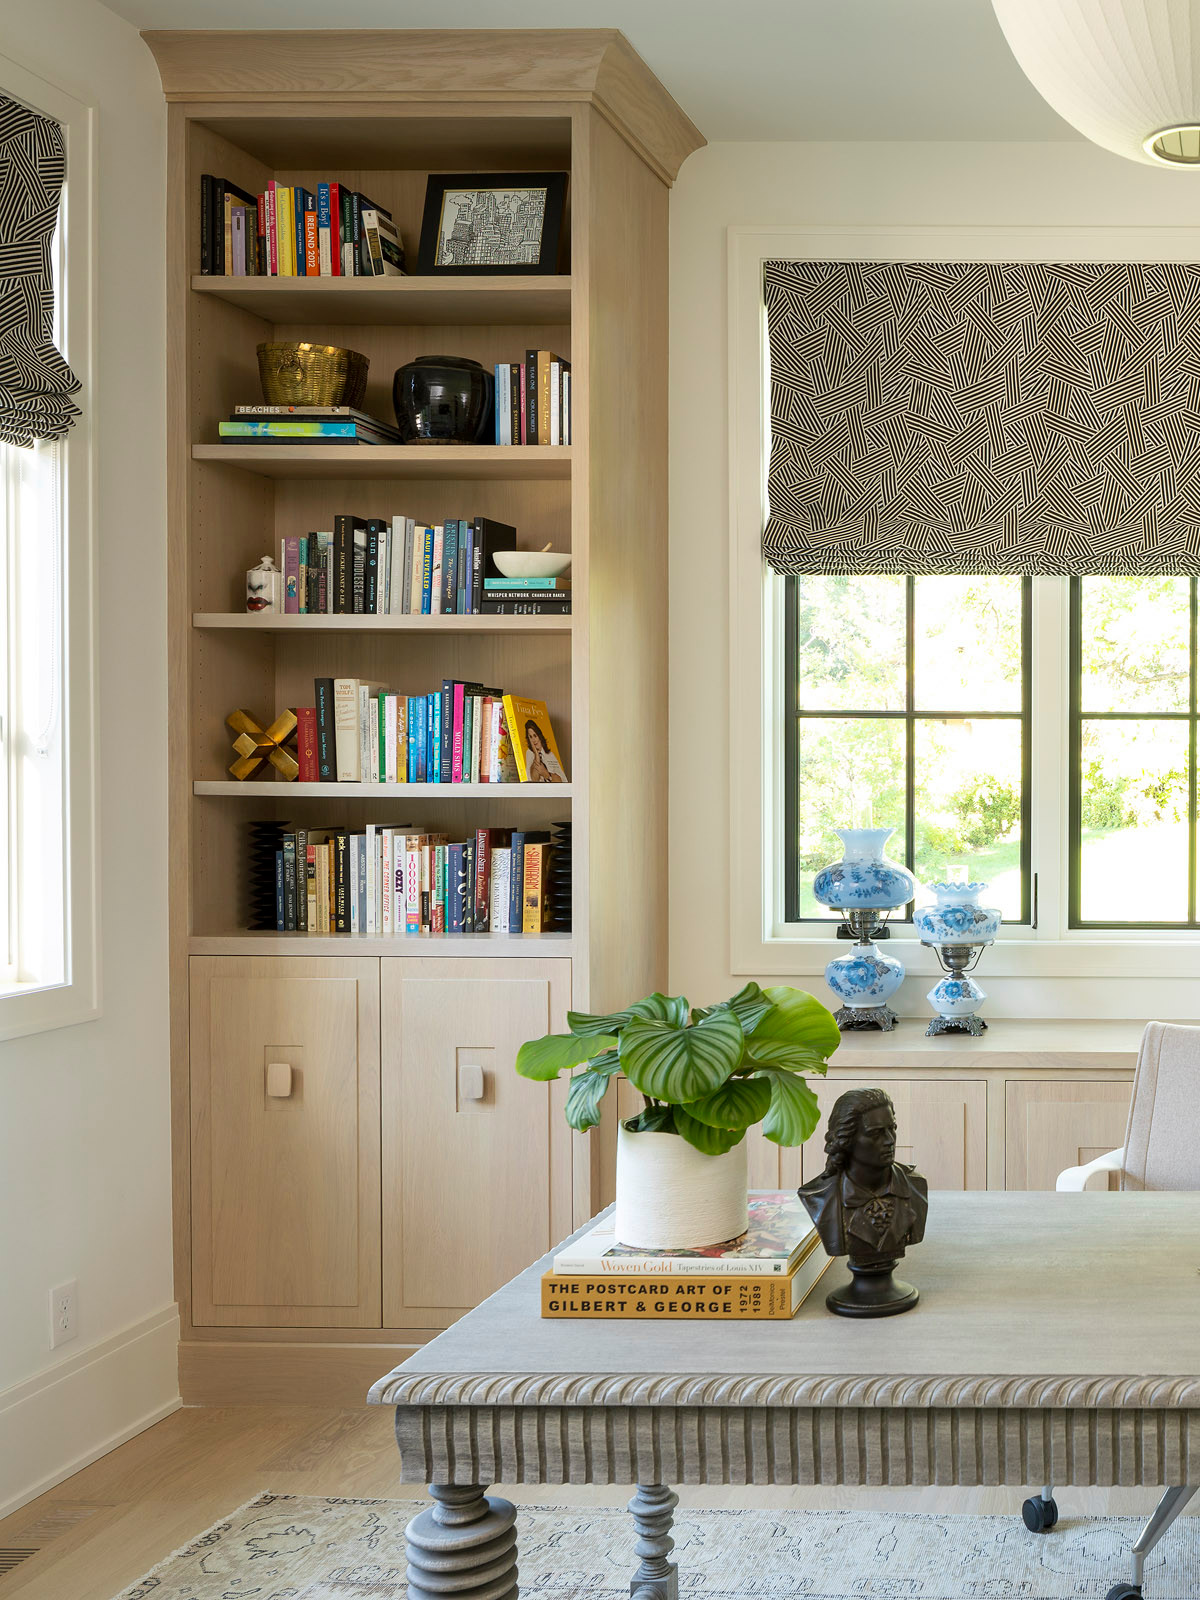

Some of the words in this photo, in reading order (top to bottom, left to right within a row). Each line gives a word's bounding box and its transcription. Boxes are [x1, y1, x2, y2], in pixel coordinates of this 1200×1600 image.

[320, 188, 328, 200] It's
[319, 208, 328, 225] Boy!
[307, 215, 315, 248] IRELAND
[308, 250, 316, 268] 2012
[354, 555, 364, 594] MIDDLESEX
[423, 555, 431, 590] REVEALED
[298, 831, 306, 855] Cilka's
[478, 832, 487, 857] DANIELLE
[298, 856, 306, 885] Journey
[395, 869, 404, 894] OZZY
[525, 851, 540, 890] SHANTARAM
[601, 1260, 641, 1272] Woven
[644, 1260, 672, 1272] Gold
[677, 1264, 715, 1272] Tapestries
[549, 1284, 580, 1294] THE
[586, 1284, 669, 1295] POSTCARD
[676, 1285, 706, 1295] ART
[712, 1285, 732, 1295] OF
[739, 1285, 748, 1313] 1972
[752, 1286, 761, 1313] 1989
[548, 1301, 628, 1312] GILBERT
[635, 1301, 646, 1312] &
[654, 1301, 732, 1313] GEORGE
